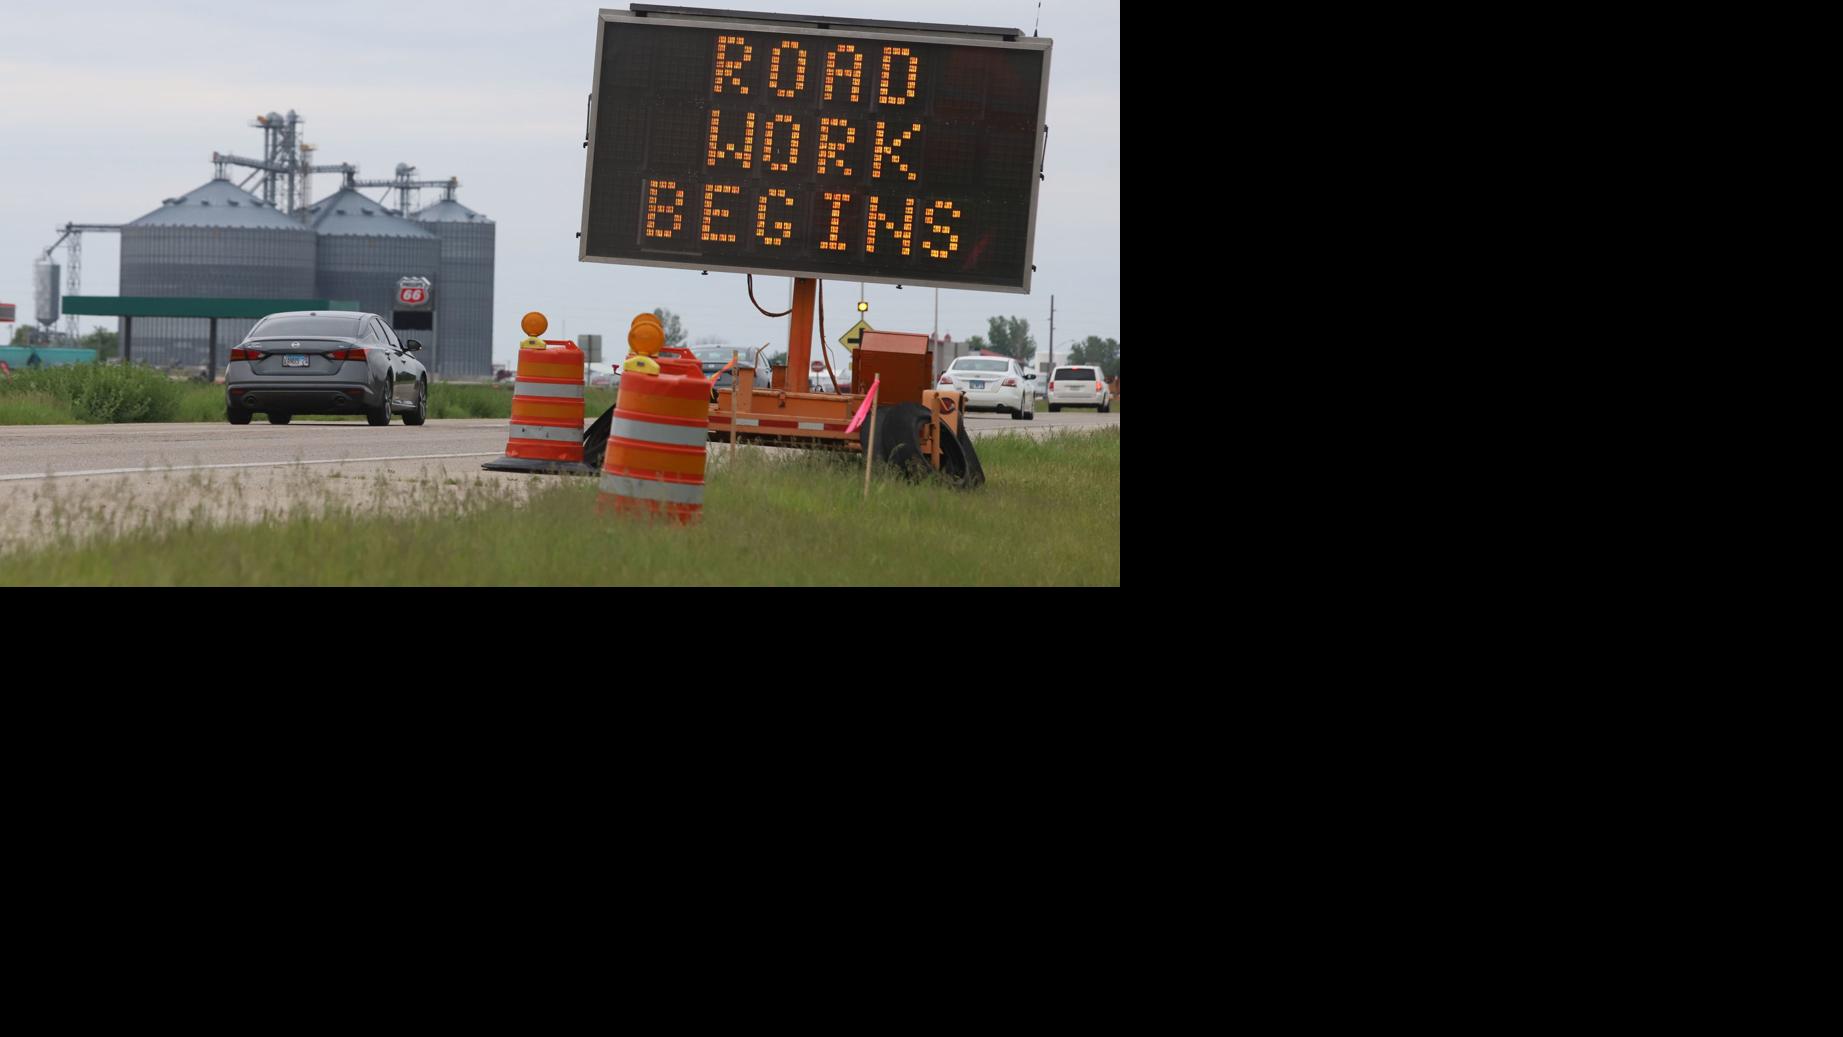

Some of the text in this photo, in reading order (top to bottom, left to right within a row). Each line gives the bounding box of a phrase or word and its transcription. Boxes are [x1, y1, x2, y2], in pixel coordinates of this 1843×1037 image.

[713, 35, 919, 105] ROAD
[707, 109, 921, 180] WORK
[645, 180, 961, 259] BEGINS
[403, 289, 421, 300] 66
